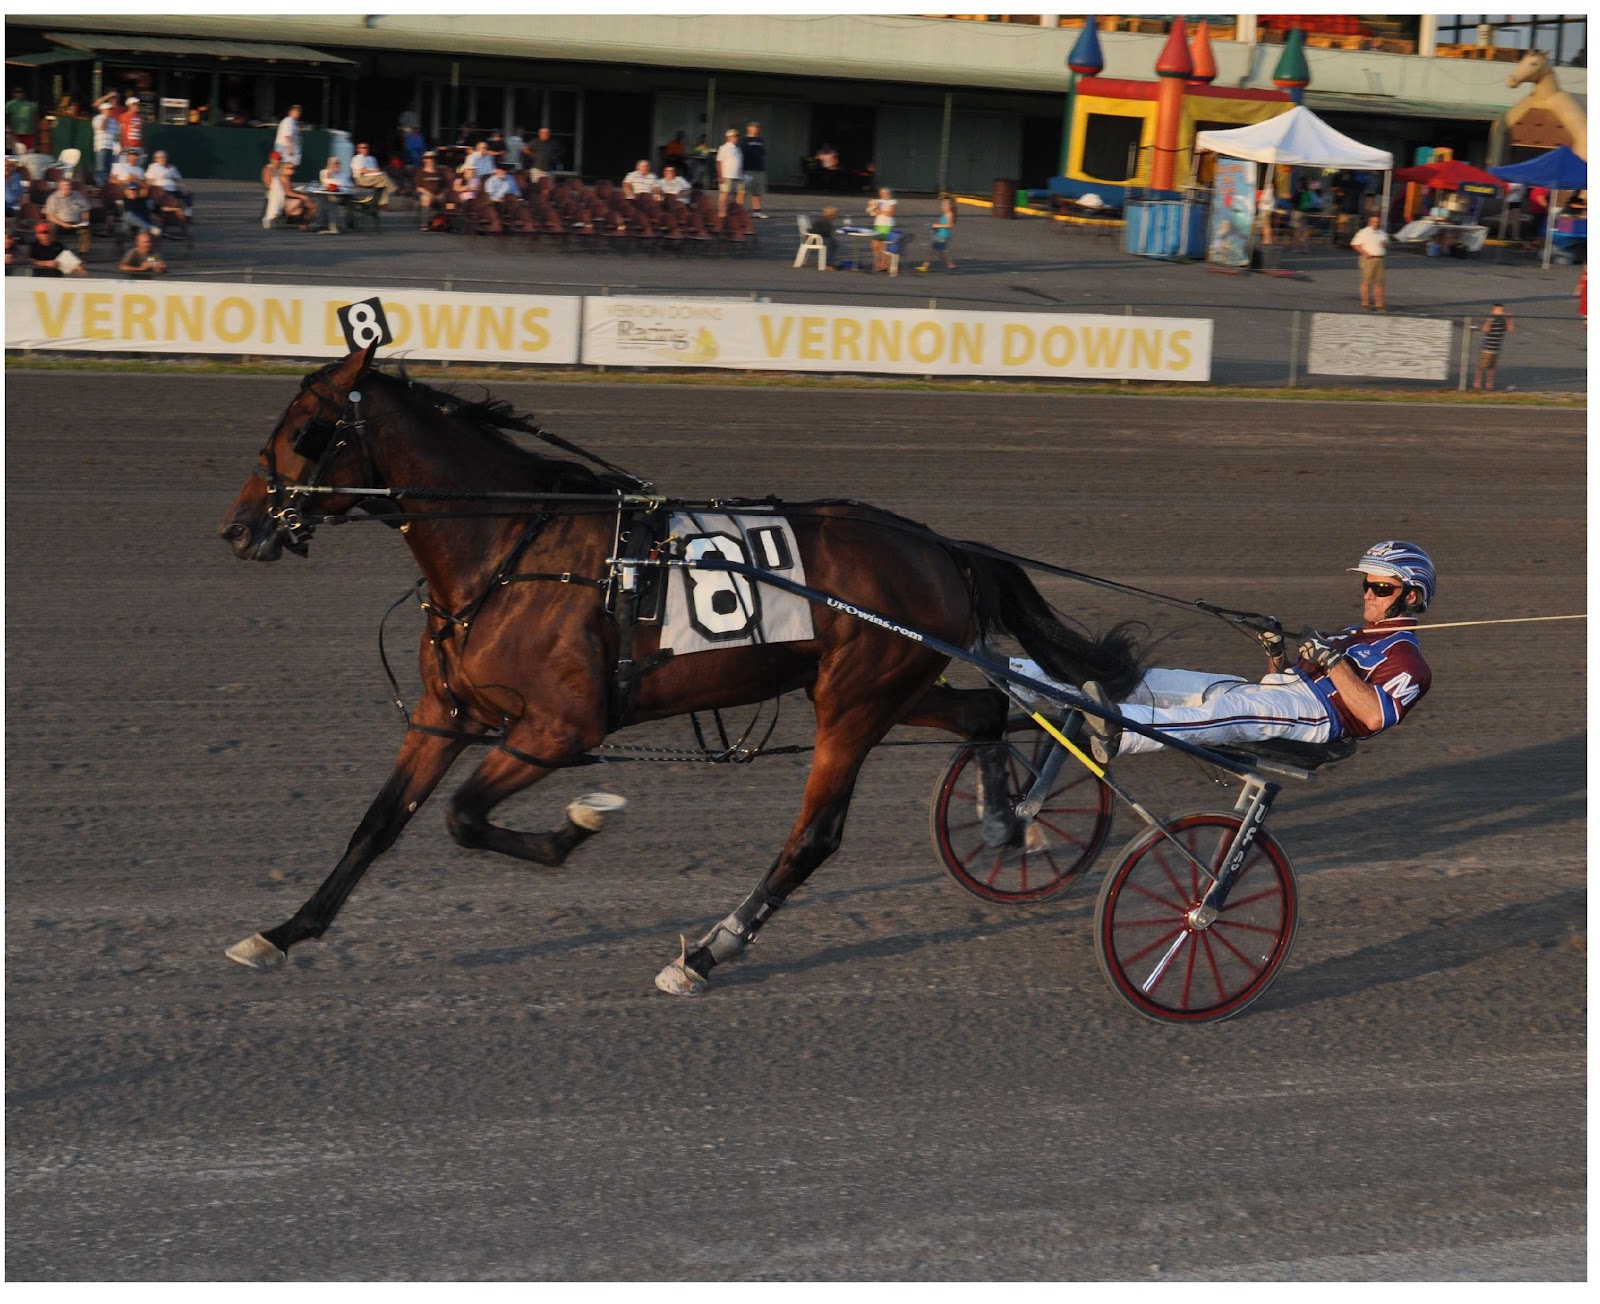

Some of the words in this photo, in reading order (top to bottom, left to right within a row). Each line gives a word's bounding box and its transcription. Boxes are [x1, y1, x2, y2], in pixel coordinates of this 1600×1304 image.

[32, 290, 302, 346] VERNON
[325, 300, 551, 352] DOWNS
[347, 303, 383, 350] 8
[758, 314, 985, 364] VERNON
[1002, 322, 1193, 371] DOWNS
[683, 533, 759, 639] 8
[1382, 671, 1420, 706] M
